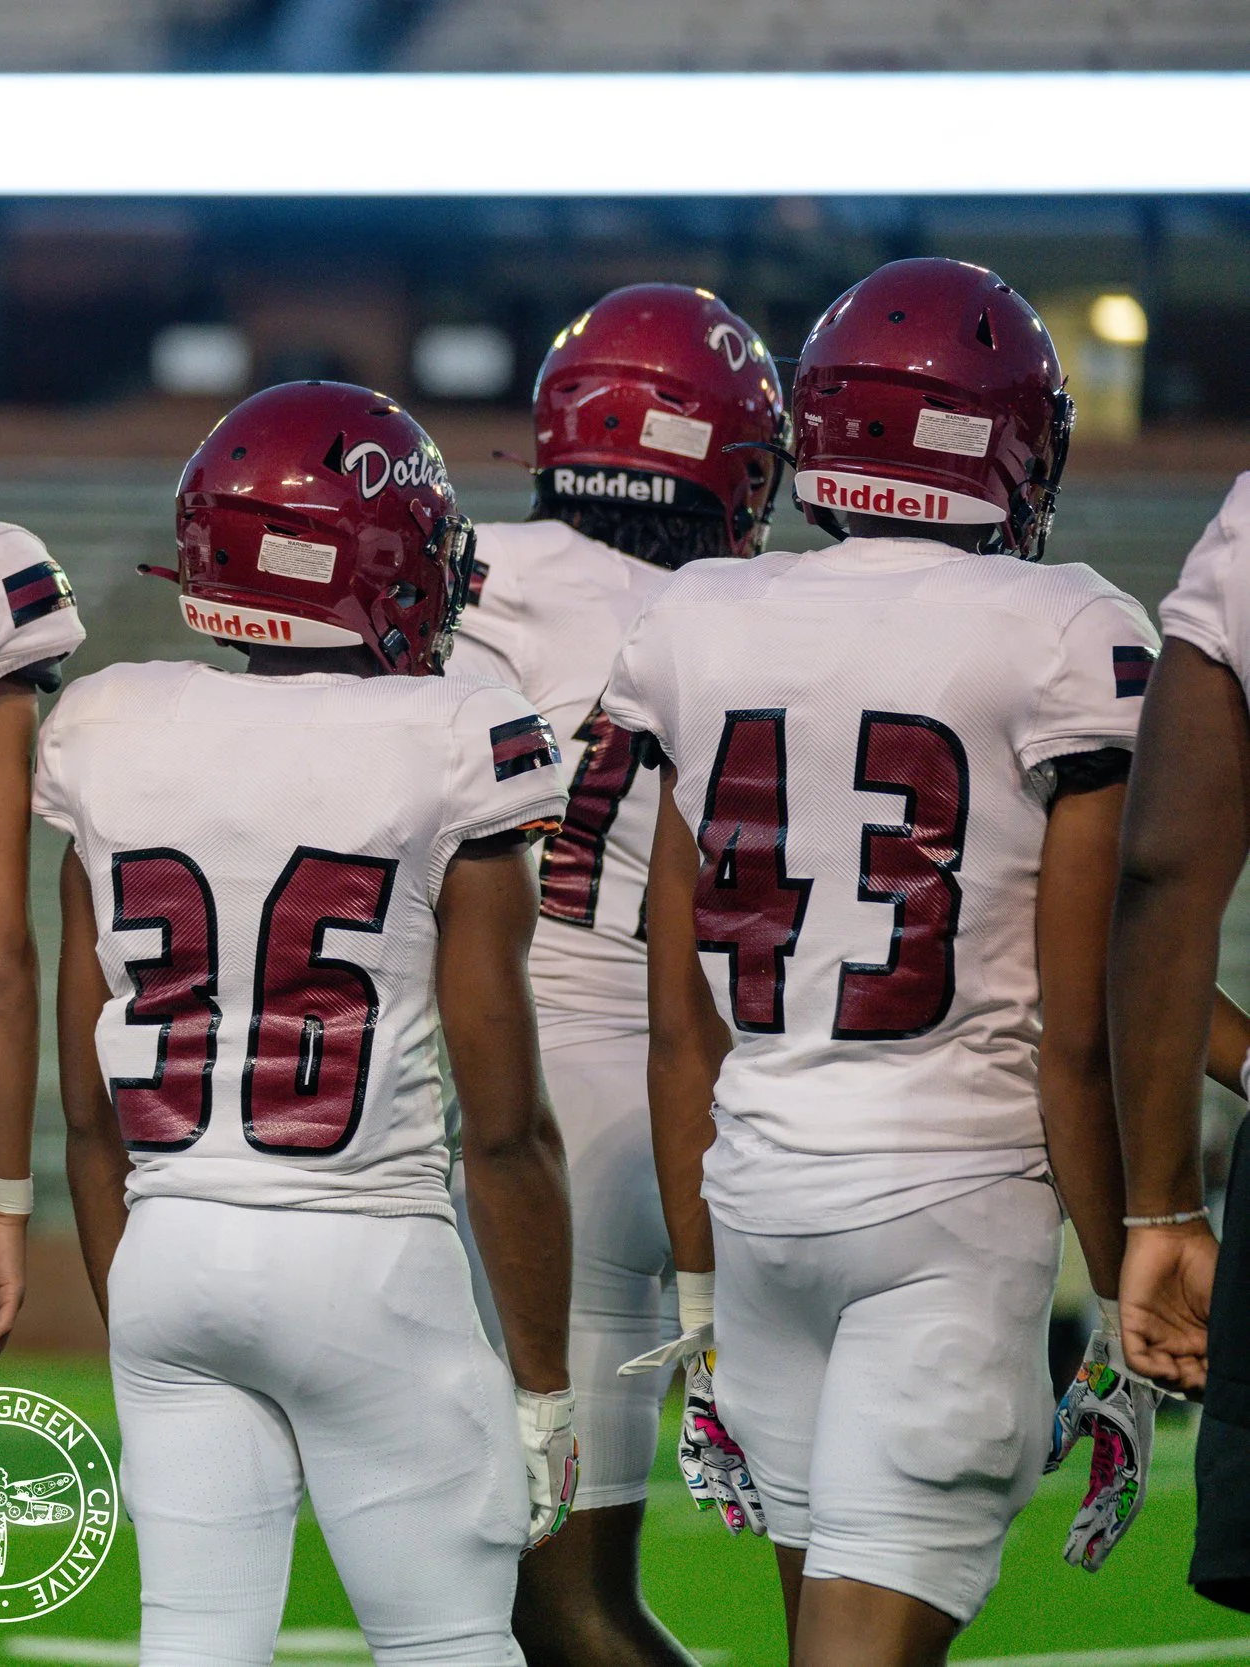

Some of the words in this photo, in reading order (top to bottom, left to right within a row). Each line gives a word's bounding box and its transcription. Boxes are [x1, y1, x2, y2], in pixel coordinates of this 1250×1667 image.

[944, 414, 970, 423] WARNING
[553, 468, 676, 504] Riddell
[816, 476, 949, 520] Riddell
[287, 541, 313, 549] WARNING
[184, 602, 292, 643] Riddell
[694, 708, 970, 1041] 43
[109, 845, 399, 1156] 36
